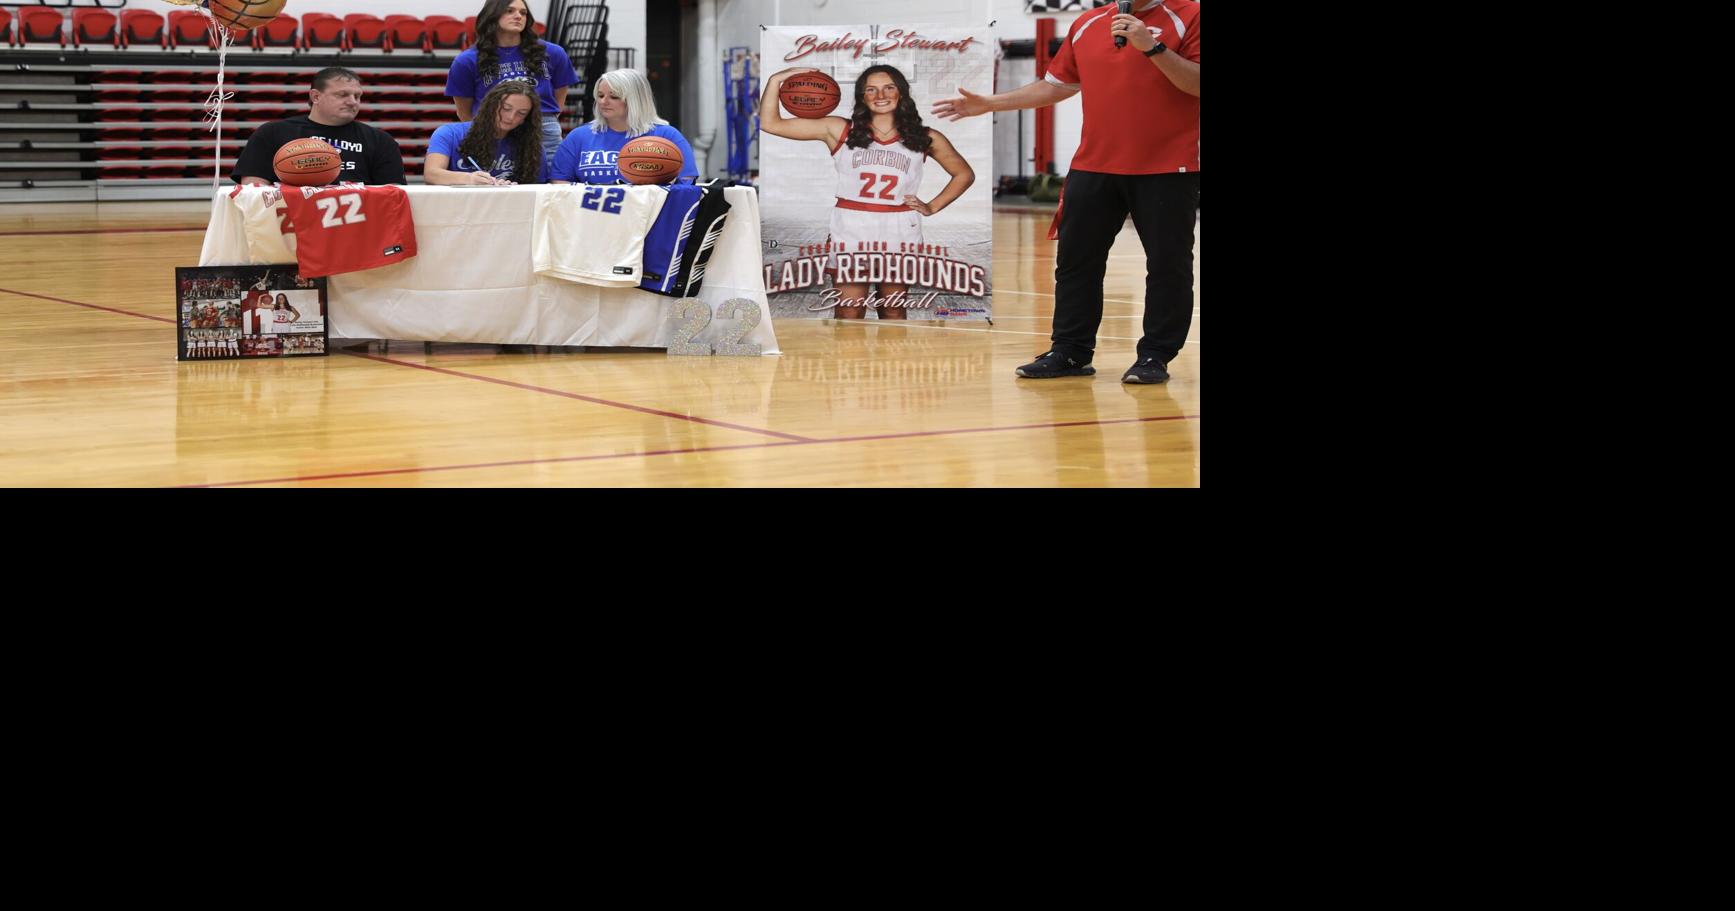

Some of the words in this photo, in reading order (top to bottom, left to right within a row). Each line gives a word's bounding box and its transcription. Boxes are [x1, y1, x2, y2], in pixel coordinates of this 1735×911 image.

[783, 32, 870, 61] Bailey
[874, 28, 985, 53] Stewart
[579, 150, 620, 167] EAG
[852, 149, 912, 174] CORBIN
[859, 172, 899, 200] 22
[316, 193, 366, 229] 22
[581, 186, 626, 215] 22
[858, 241, 888, 252] HIGH
[900, 241, 950, 257] SCHOOL
[764, 254, 831, 295] LADY
[835, 251, 986, 298] REDHOUNDS
[808, 287, 940, 311] Basketball
[667, 297, 762, 356] 22
